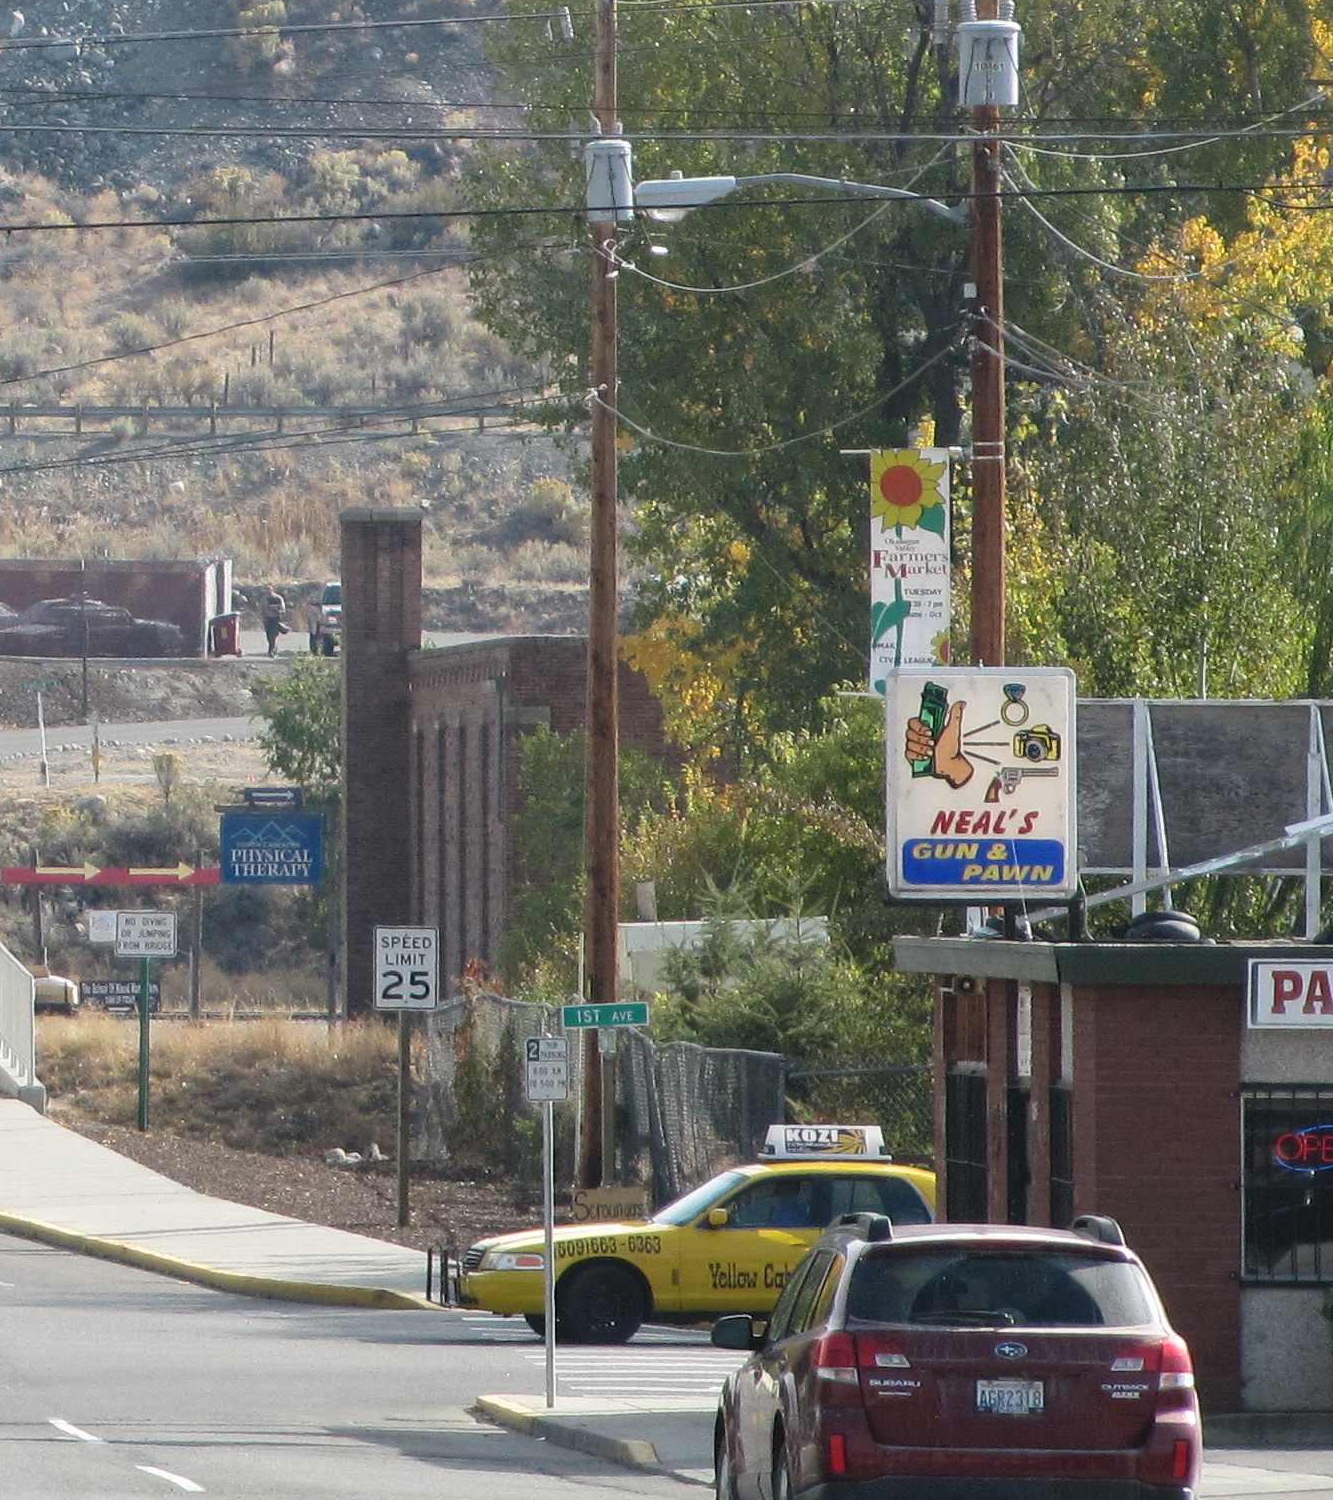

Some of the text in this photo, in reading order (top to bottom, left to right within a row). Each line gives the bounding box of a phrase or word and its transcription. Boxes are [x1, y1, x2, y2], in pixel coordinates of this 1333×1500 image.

[873, 550, 949, 568] Farmers
[884, 562, 947, 578] Market
[930, 809, 1039, 835] NEAL'S
[231, 848, 313, 863] PHYSICAL
[912, 842, 1008, 860] GUN &
[231, 863, 312, 877] THERAPY
[962, 864, 1054, 881] PAWN
[124, 917, 167, 926] NO DIVING
[120, 929, 171, 939] OR JUMPING
[117, 941, 141, 950] FROM
[381, 936, 432, 949] SPEED
[385, 953, 426, 966] LIMIT
[381, 970, 430, 1000] 25
[1271, 970, 1333, 1014] PA
[577, 1010, 634, 1023] 1ST AVE
[528, 1041, 539, 1059] 2
[786, 1129, 839, 1143] KOZI
[708, 1263, 757, 1289] Yellow
[869, 1379, 921, 1387] SUBARU
[980, 1390, 1041, 1407] AGR2318
